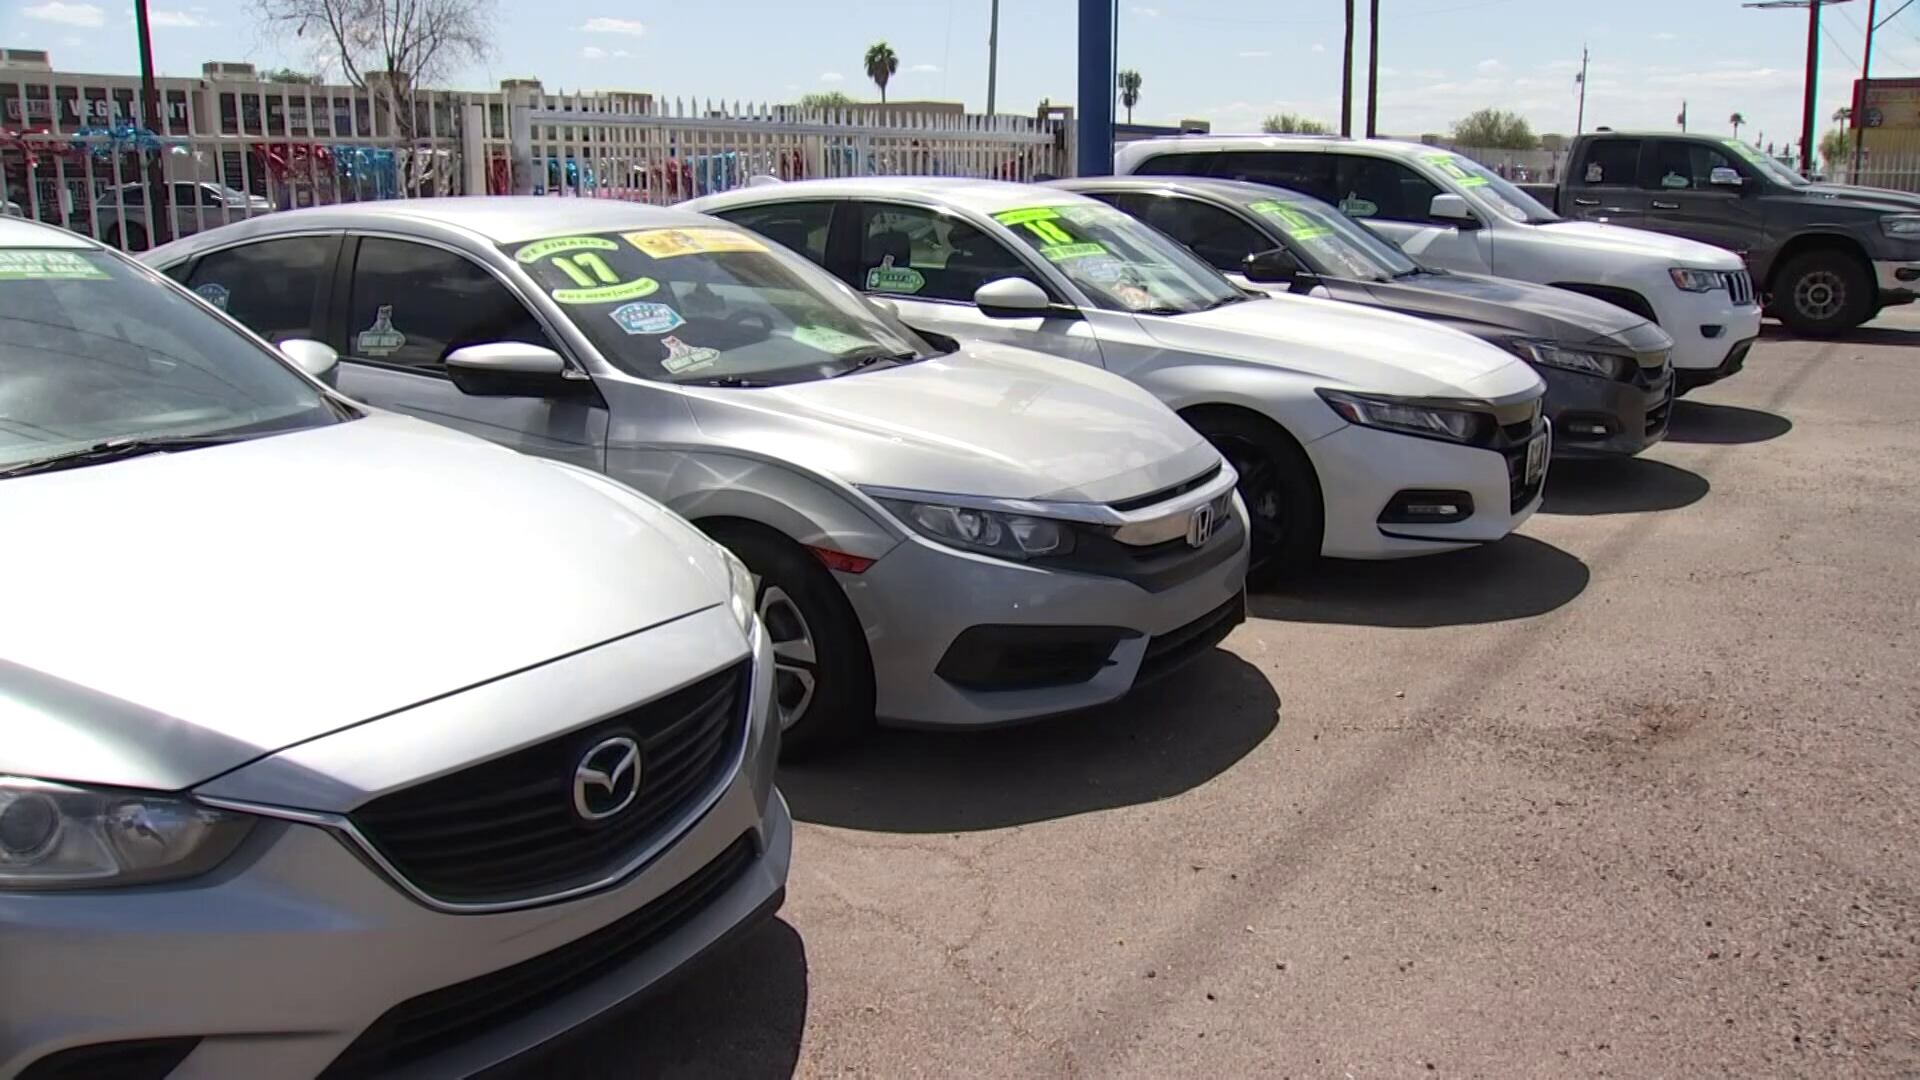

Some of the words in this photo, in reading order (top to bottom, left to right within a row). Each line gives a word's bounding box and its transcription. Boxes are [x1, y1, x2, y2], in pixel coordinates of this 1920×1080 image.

[69, 99, 122, 117] VEGA
[1023, 219, 1074, 245] 18
[551, 252, 620, 287] 17
